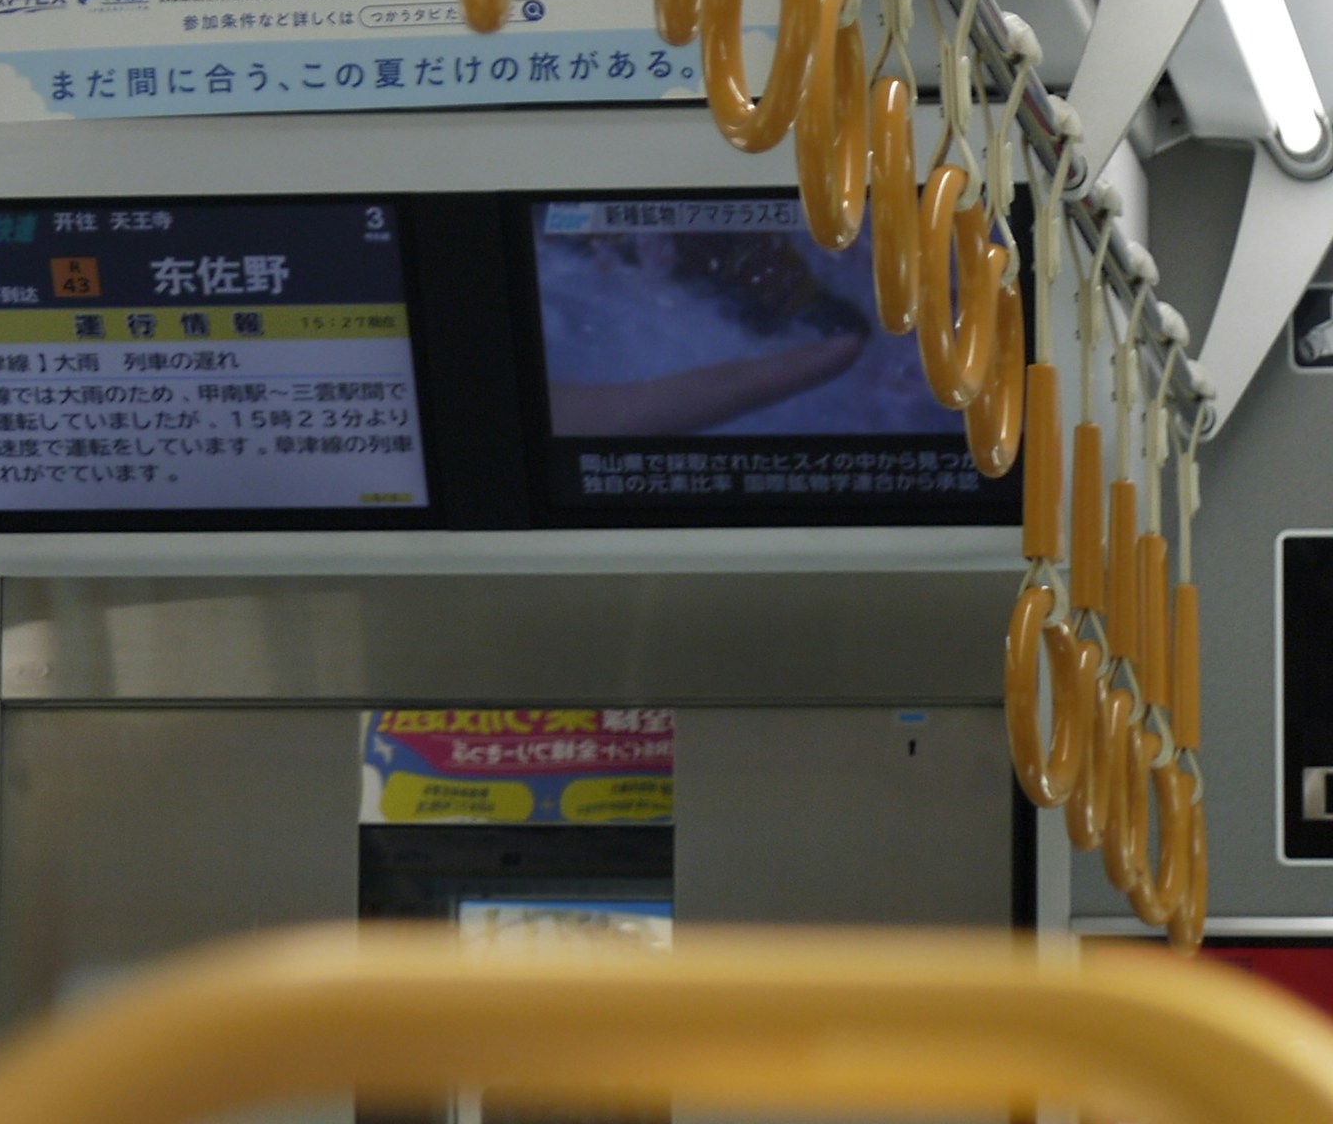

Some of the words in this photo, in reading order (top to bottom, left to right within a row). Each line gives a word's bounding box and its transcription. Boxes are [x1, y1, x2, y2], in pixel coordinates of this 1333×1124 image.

[182, 11, 355, 31] 参加条件など詳しくは
[369, 5, 441, 25] つかうタビ
[49, 46, 697, 101] まだ間に合う、この夏だけの旅がある。
[109, 210, 173, 232] 天王寺
[364, 206, 386, 230] 3
[62, 277, 91, 294] 43
[150, 254, 290, 296] 东佐野
[123, 349, 241, 372] 列車の遅れ
